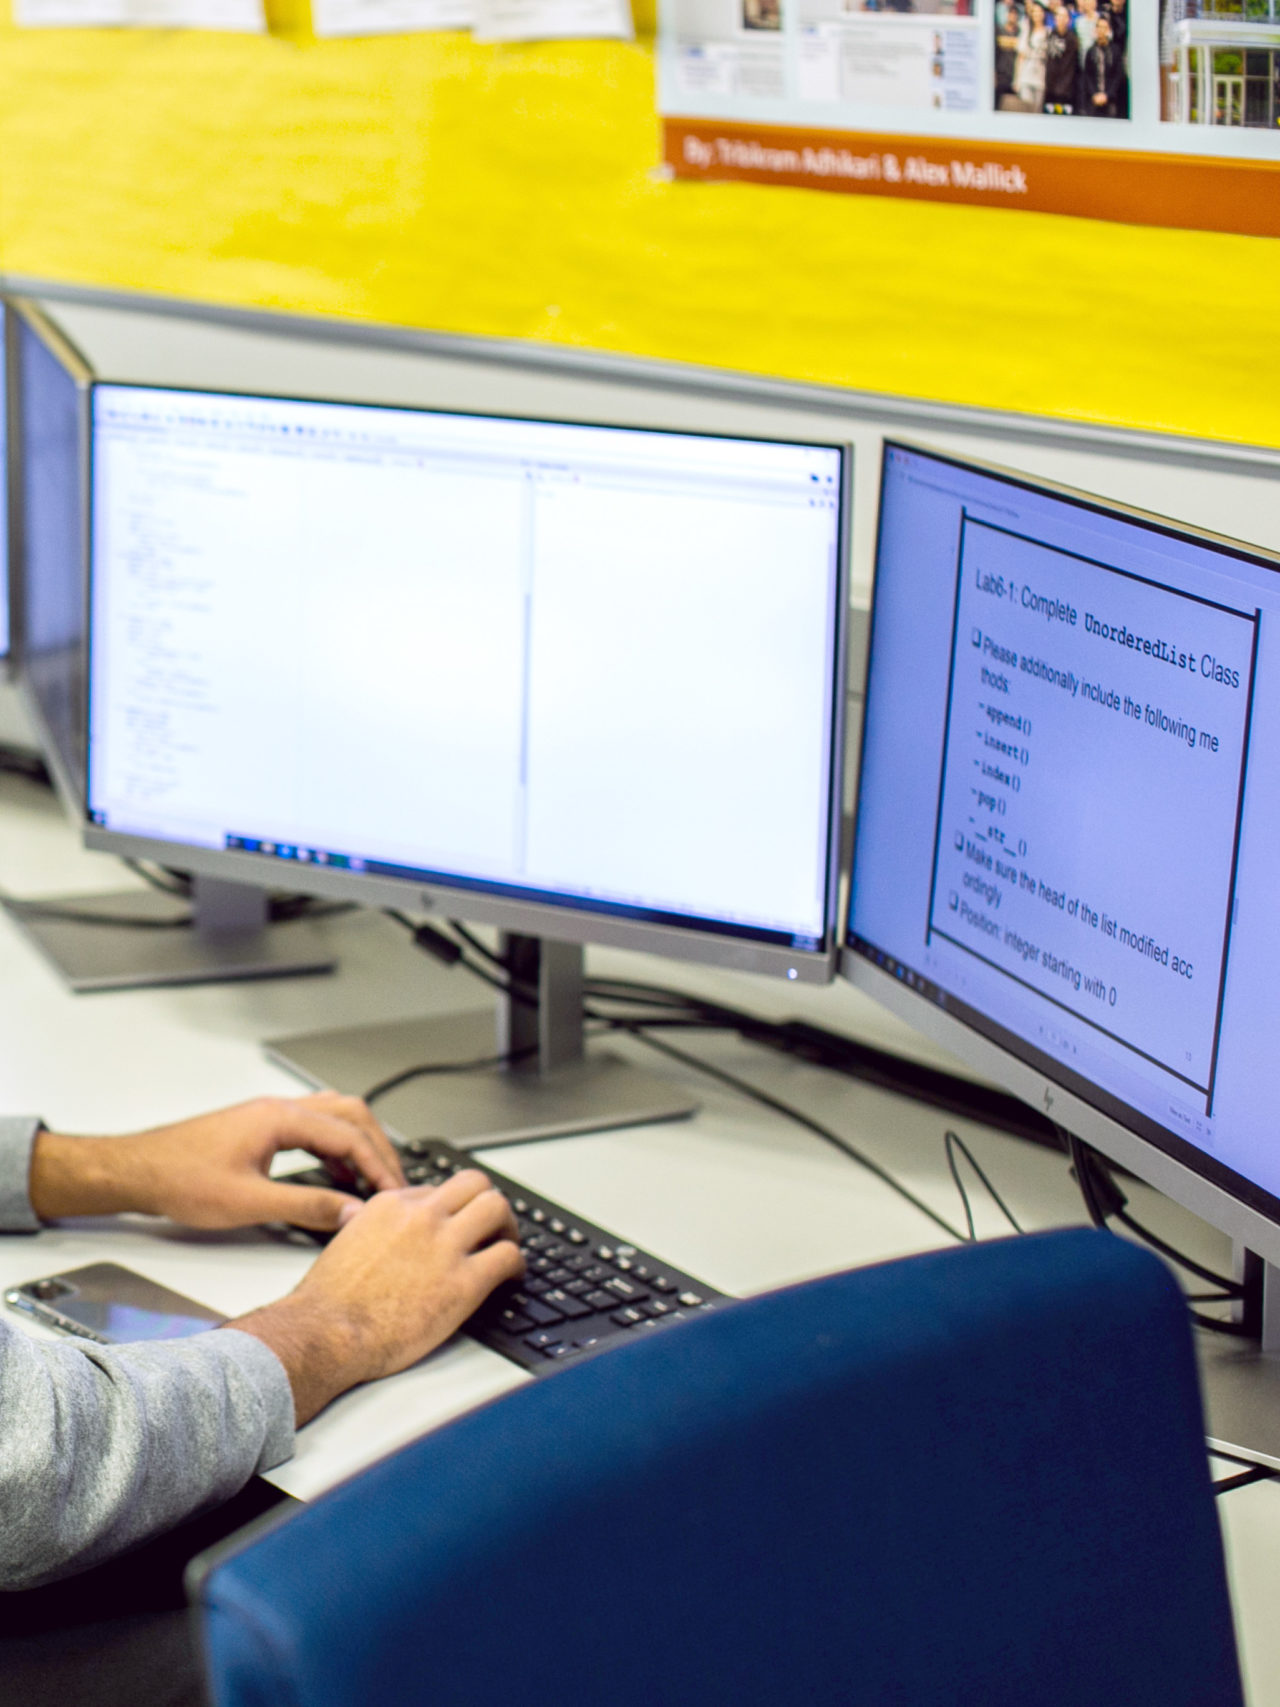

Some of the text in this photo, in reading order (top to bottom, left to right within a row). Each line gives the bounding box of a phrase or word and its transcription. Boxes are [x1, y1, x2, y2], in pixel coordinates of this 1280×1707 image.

[800, 146, 880, 180] Adhikari
[882, 153, 902, 182] &
[904, 156, 950, 186] Alex
[951, 160, 1028, 194] Mallick
[1021, 584, 1078, 623] Complete
[1084, 611, 1196, 673] UnorderedList
[1200, 653, 1240, 689] Class
[983, 634, 1220, 752] Please additionally include the following me
[962, 871, 1003, 910] ordingly
[965, 839, 1194, 980] Make sure the head of the list modified acc
[1003, 924, 1040, 962] integer
[1041, 951, 1082, 991] starting
[1083, 974, 1107, 1002] with
